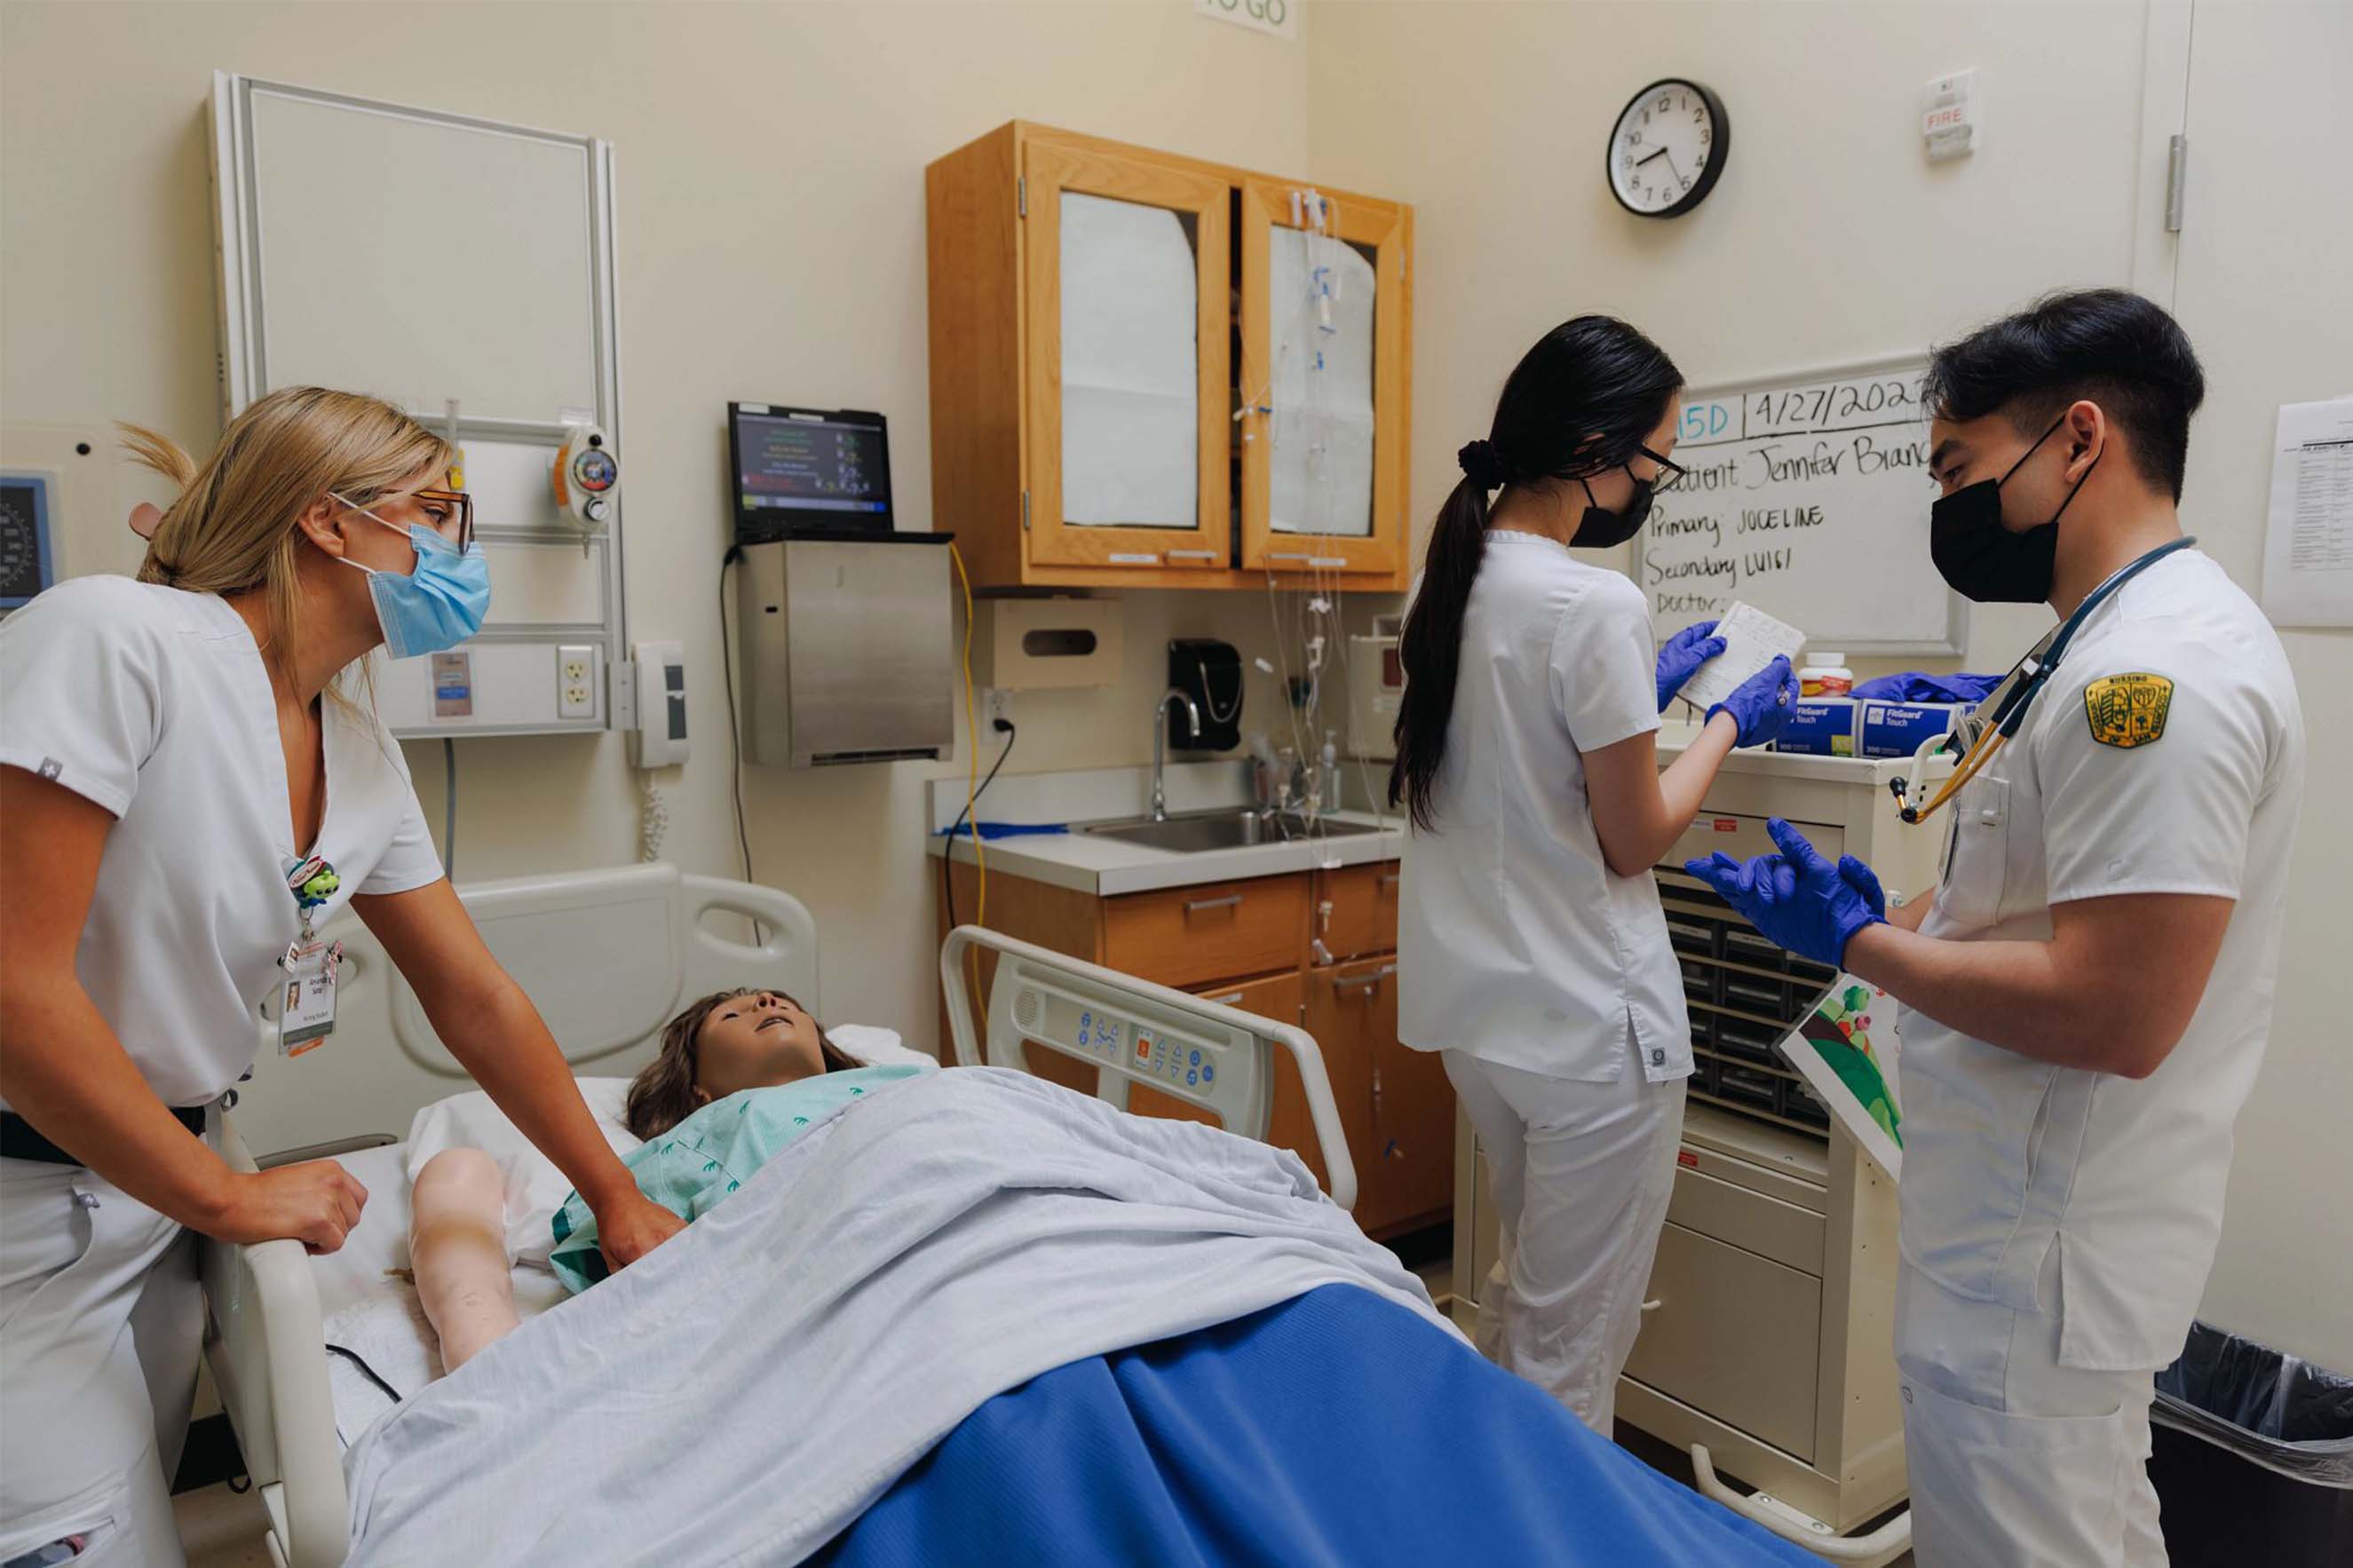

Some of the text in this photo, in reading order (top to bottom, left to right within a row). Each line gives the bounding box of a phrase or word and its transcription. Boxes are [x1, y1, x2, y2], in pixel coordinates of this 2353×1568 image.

[1658, 98, 1671, 113] 12
[1694, 107, 1704, 123] 2
[1927, 107, 1961, 128] FIRE
[1700, 129, 1710, 144] 3
[1645, 187, 1653, 202] 7
[1663, 187, 1672, 202] 6
[1755, 379, 1923, 425] 4/27/202
[1746, 441, 1846, 489] Jennifer
[1737, 505, 1824, 535] JOCELINE
[1645, 547, 1736, 589] Secondary
[1887, 717, 1908, 727] Touch
